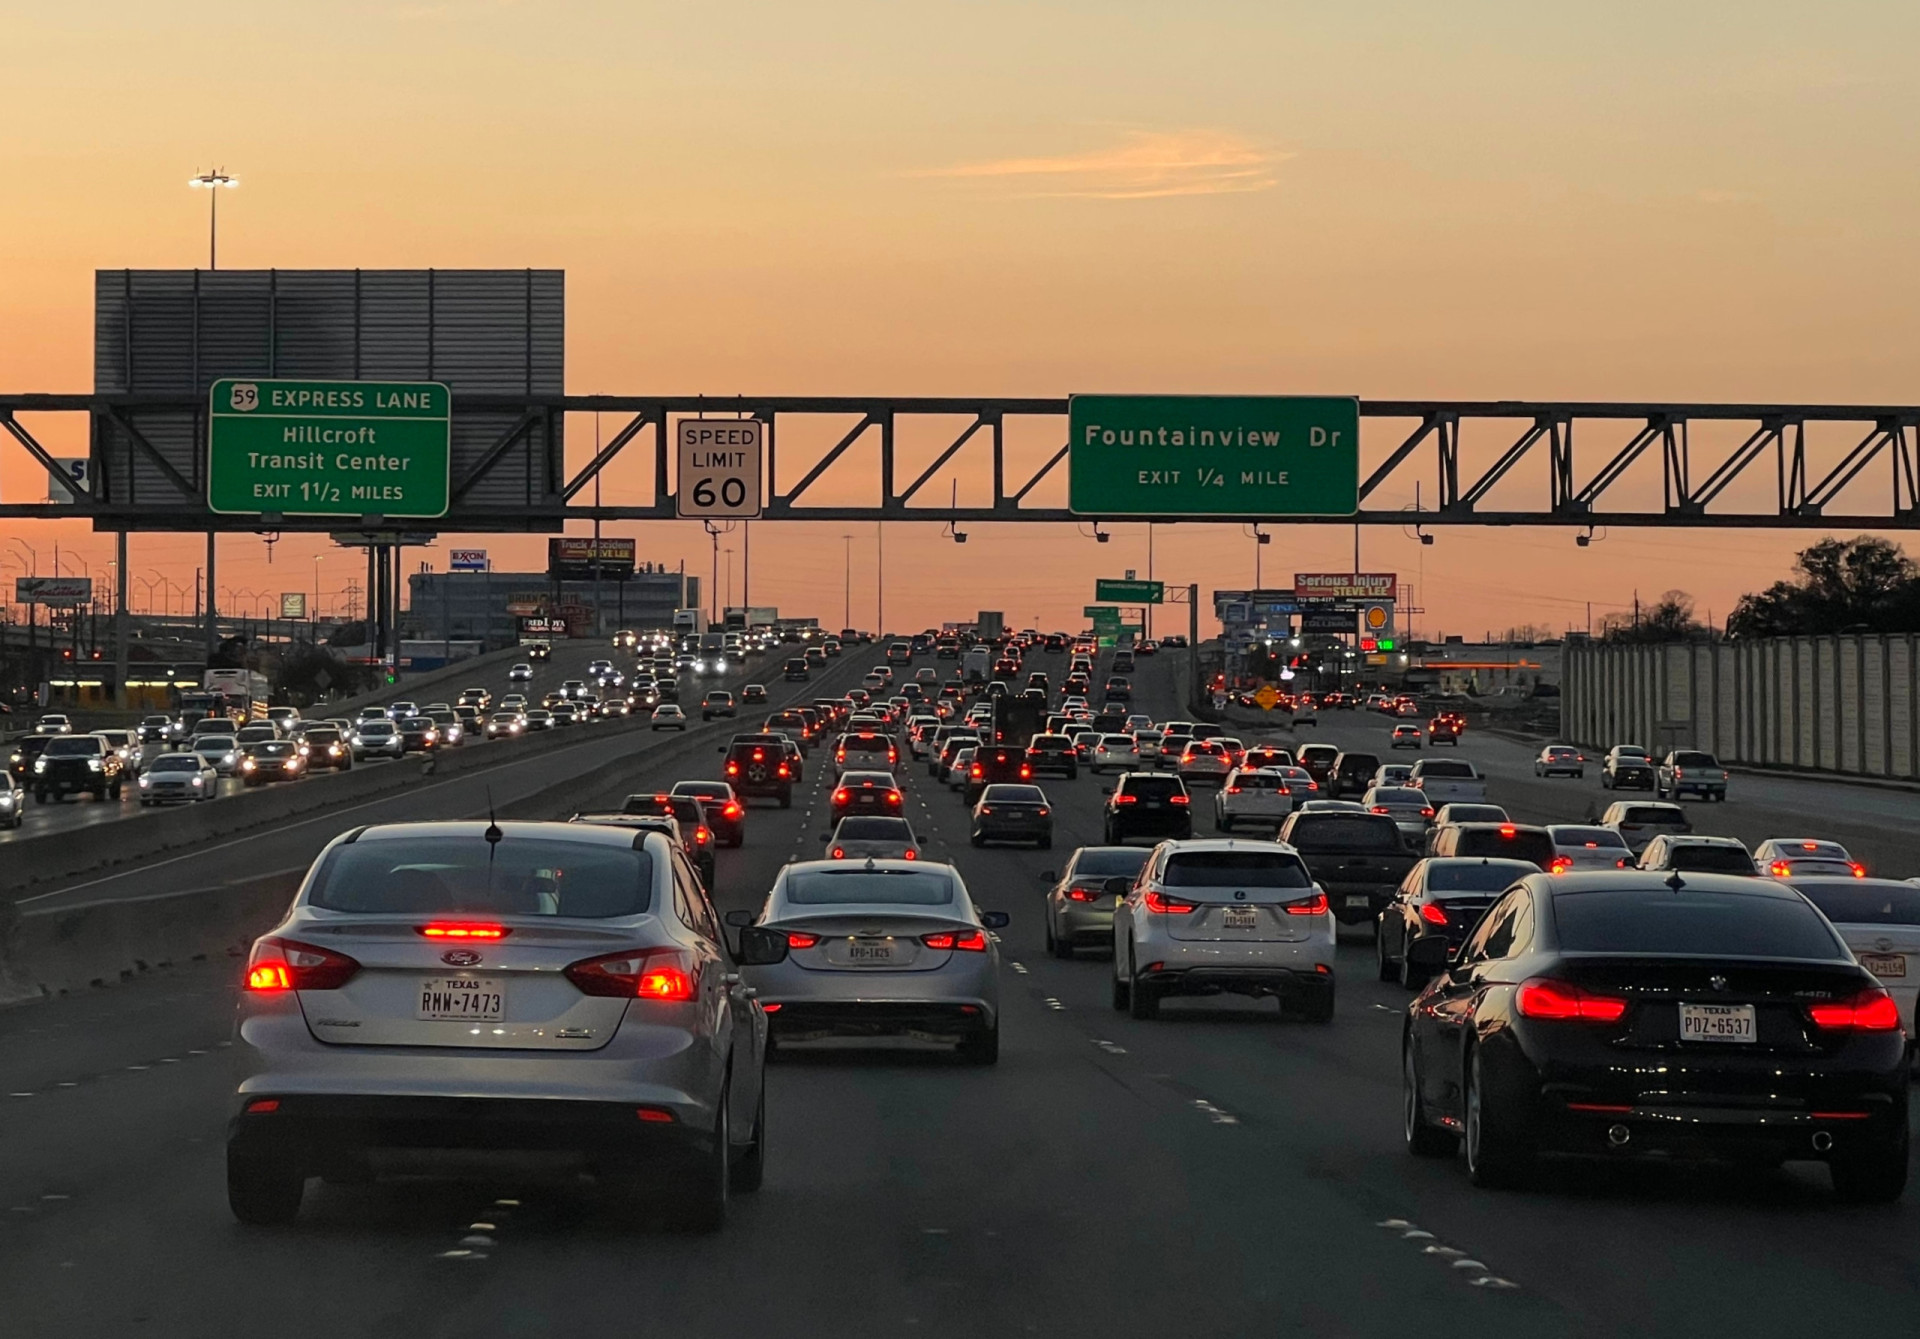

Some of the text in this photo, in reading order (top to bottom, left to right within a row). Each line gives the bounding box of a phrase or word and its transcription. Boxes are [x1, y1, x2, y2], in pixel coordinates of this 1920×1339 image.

[234, 389, 431, 409] 59 EXPRESS LANE
[283, 426, 376, 444] Hillcroft
[686, 429, 754, 445] SPEED
[1085, 425, 1341, 447] Fountainview Dr
[248, 452, 410, 471] Transit Center
[692, 452, 746, 467] LIMIT
[1138, 470, 1181, 484] EXIT
[1241, 471, 1289, 485] MILE
[253, 483, 291, 498] EXIT
[351, 486, 404, 500] MILES
[692, 477, 746, 508] 60
[560, 540, 634, 549] Truck Acident
[452, 552, 484, 563] EXXON
[587, 549, 613, 558] STVE
[614, 549, 631, 558] LEE
[1298, 574, 1392, 588] Serious Injury
[1333, 586, 1365, 596] STEVE
[1369, 586, 1388, 596] LEE
[445, 980, 480, 990] TEXAS
[1703, 1007, 1732, 1015] TEXAS
